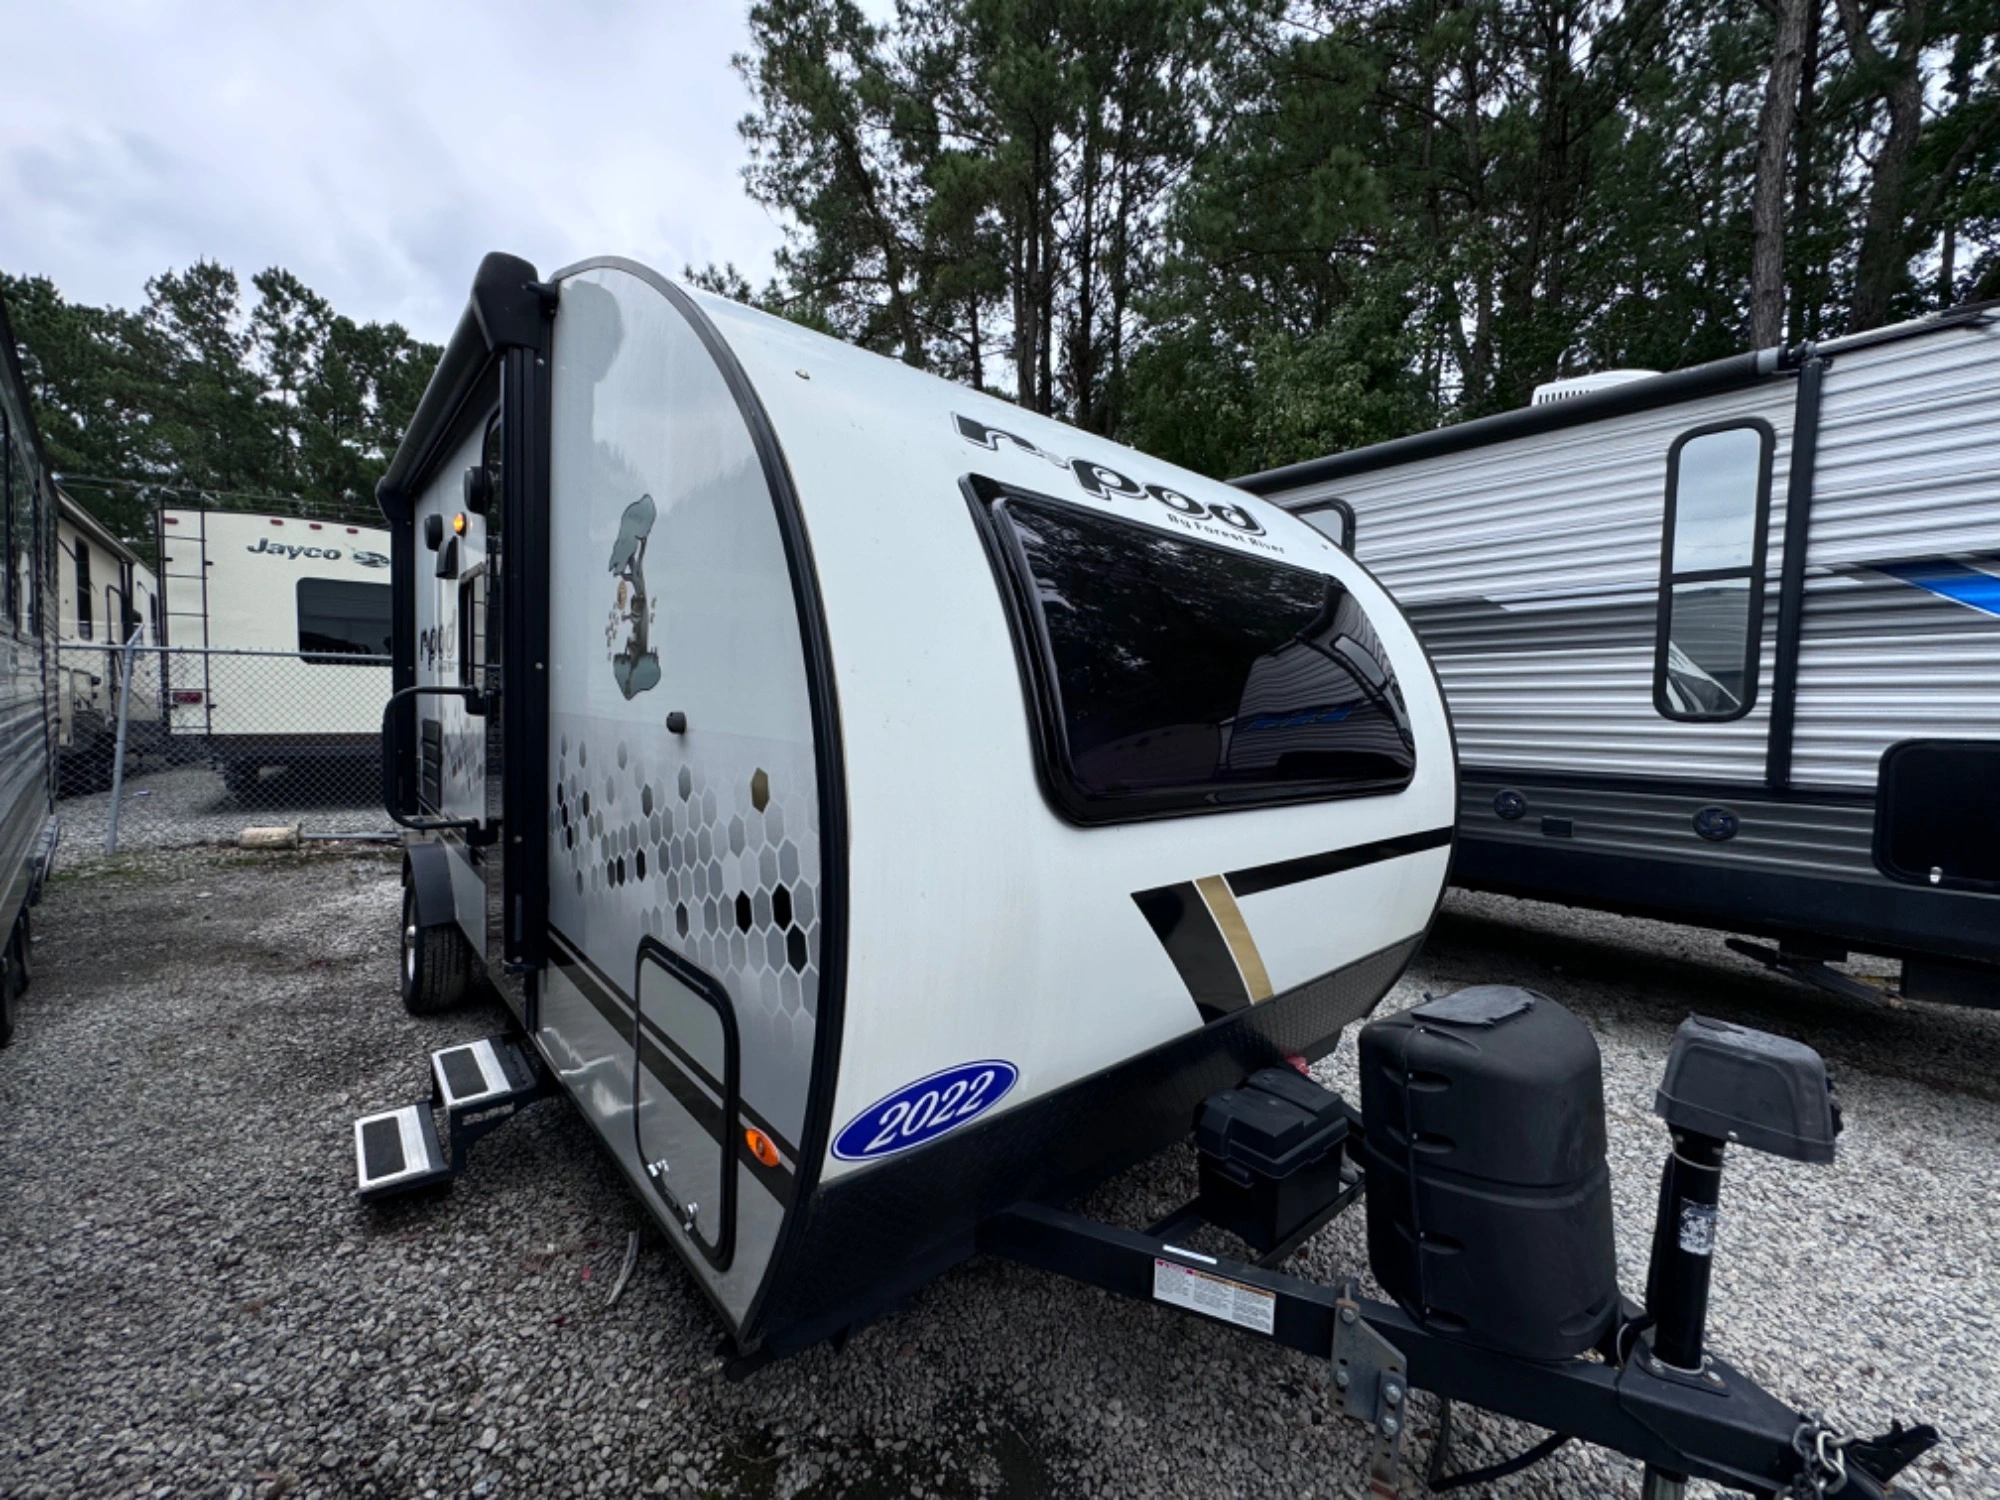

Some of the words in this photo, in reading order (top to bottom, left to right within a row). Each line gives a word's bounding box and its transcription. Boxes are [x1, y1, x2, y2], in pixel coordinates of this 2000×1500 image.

[247, 537, 342, 560] Jayco
[1194, 521, 1245, 542] Forest
[1248, 537, 1285, 554] River
[863, 1070, 995, 1152] 2022
